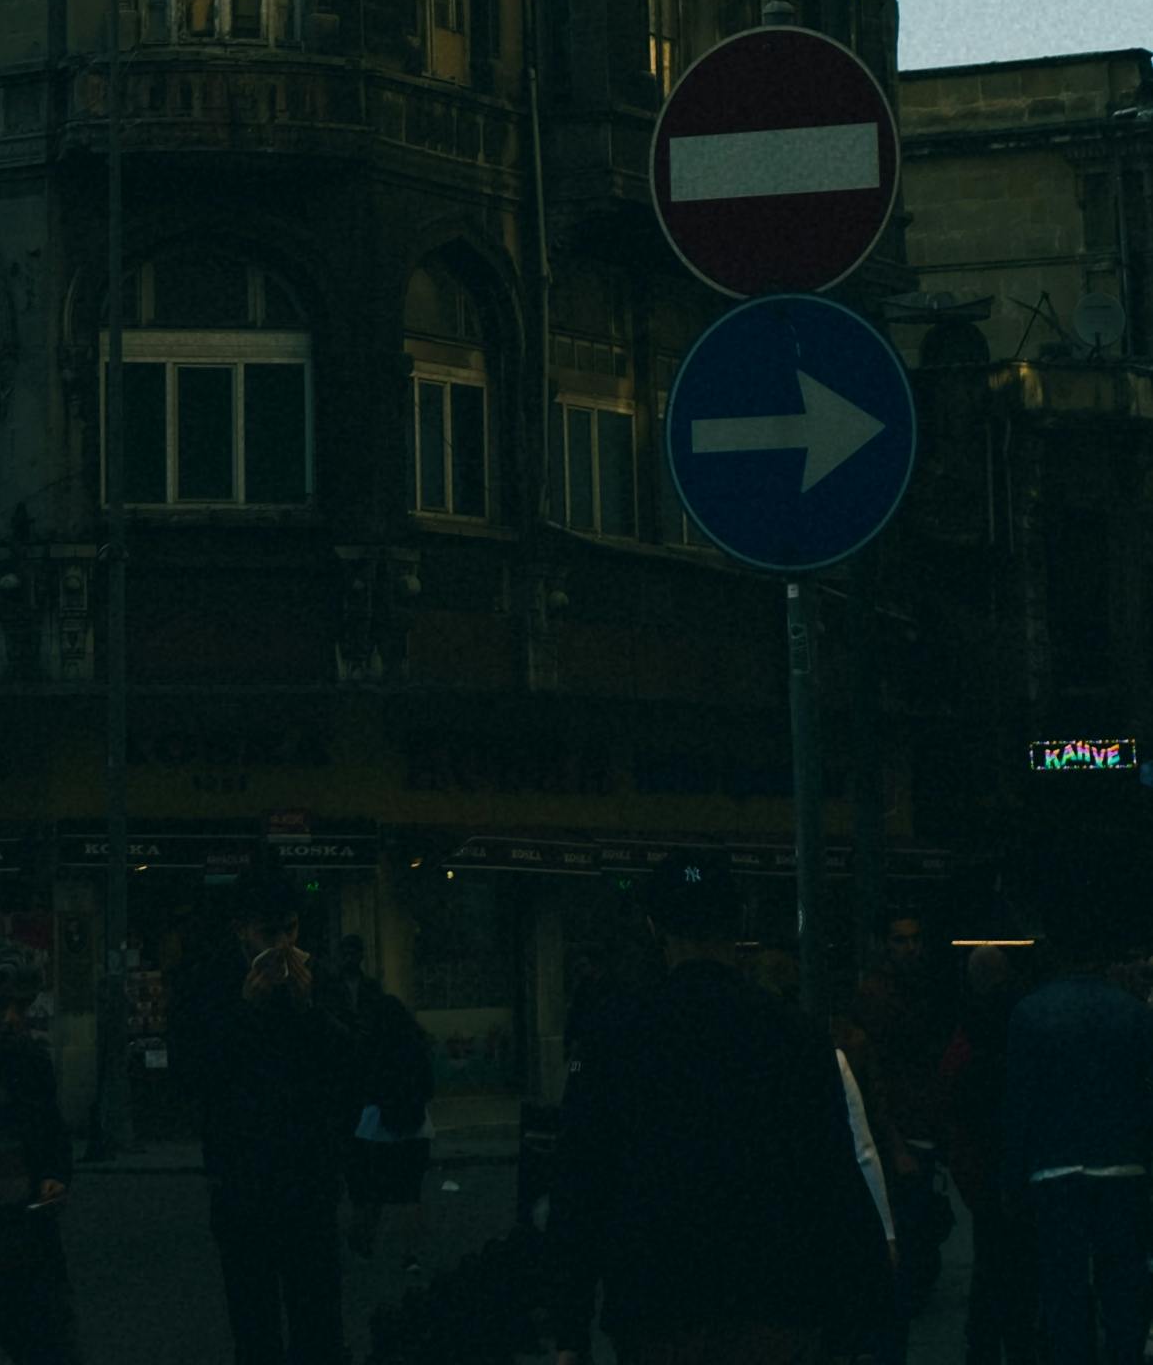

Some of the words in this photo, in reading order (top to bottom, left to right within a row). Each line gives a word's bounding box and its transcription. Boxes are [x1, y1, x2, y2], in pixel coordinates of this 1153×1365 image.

[1044, 740, 1121, 768] KAHVE
[83, 842, 161, 857] KOKA
[277, 844, 355, 857] KOSKA
